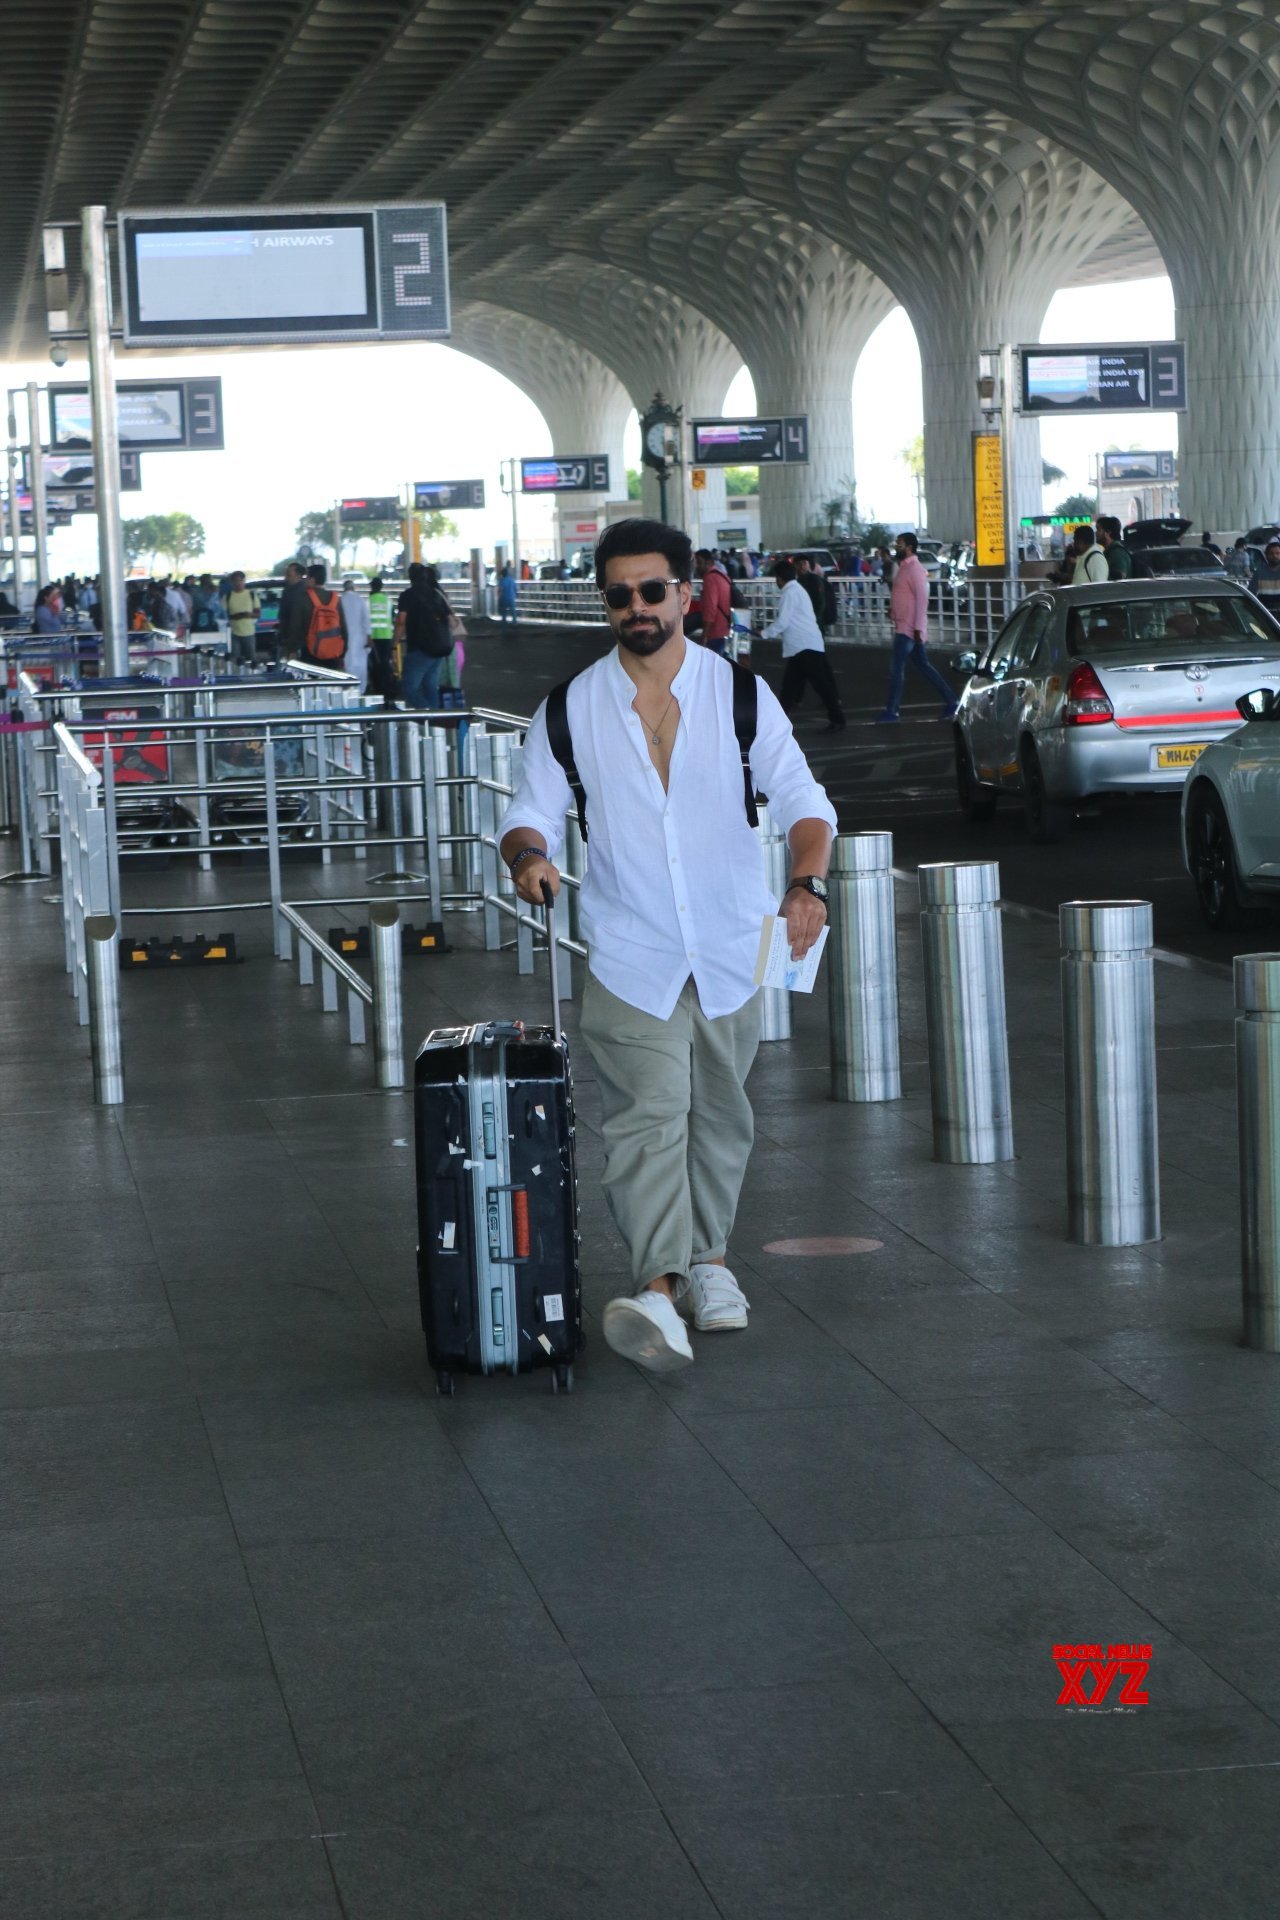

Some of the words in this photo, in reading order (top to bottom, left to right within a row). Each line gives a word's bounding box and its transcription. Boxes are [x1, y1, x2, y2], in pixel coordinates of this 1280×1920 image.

[263, 234, 335, 248] AIRWAYS
[392, 232, 432, 306] 2
[1101, 357, 1126, 366] INDIA
[1102, 369, 1127, 377] INDIA
[1115, 380, 1130, 388] AIR
[1157, 357, 1179, 397] 3
[193, 393, 217, 434] 3
[788, 426, 804, 454] 4
[593, 462, 606, 485] 5
